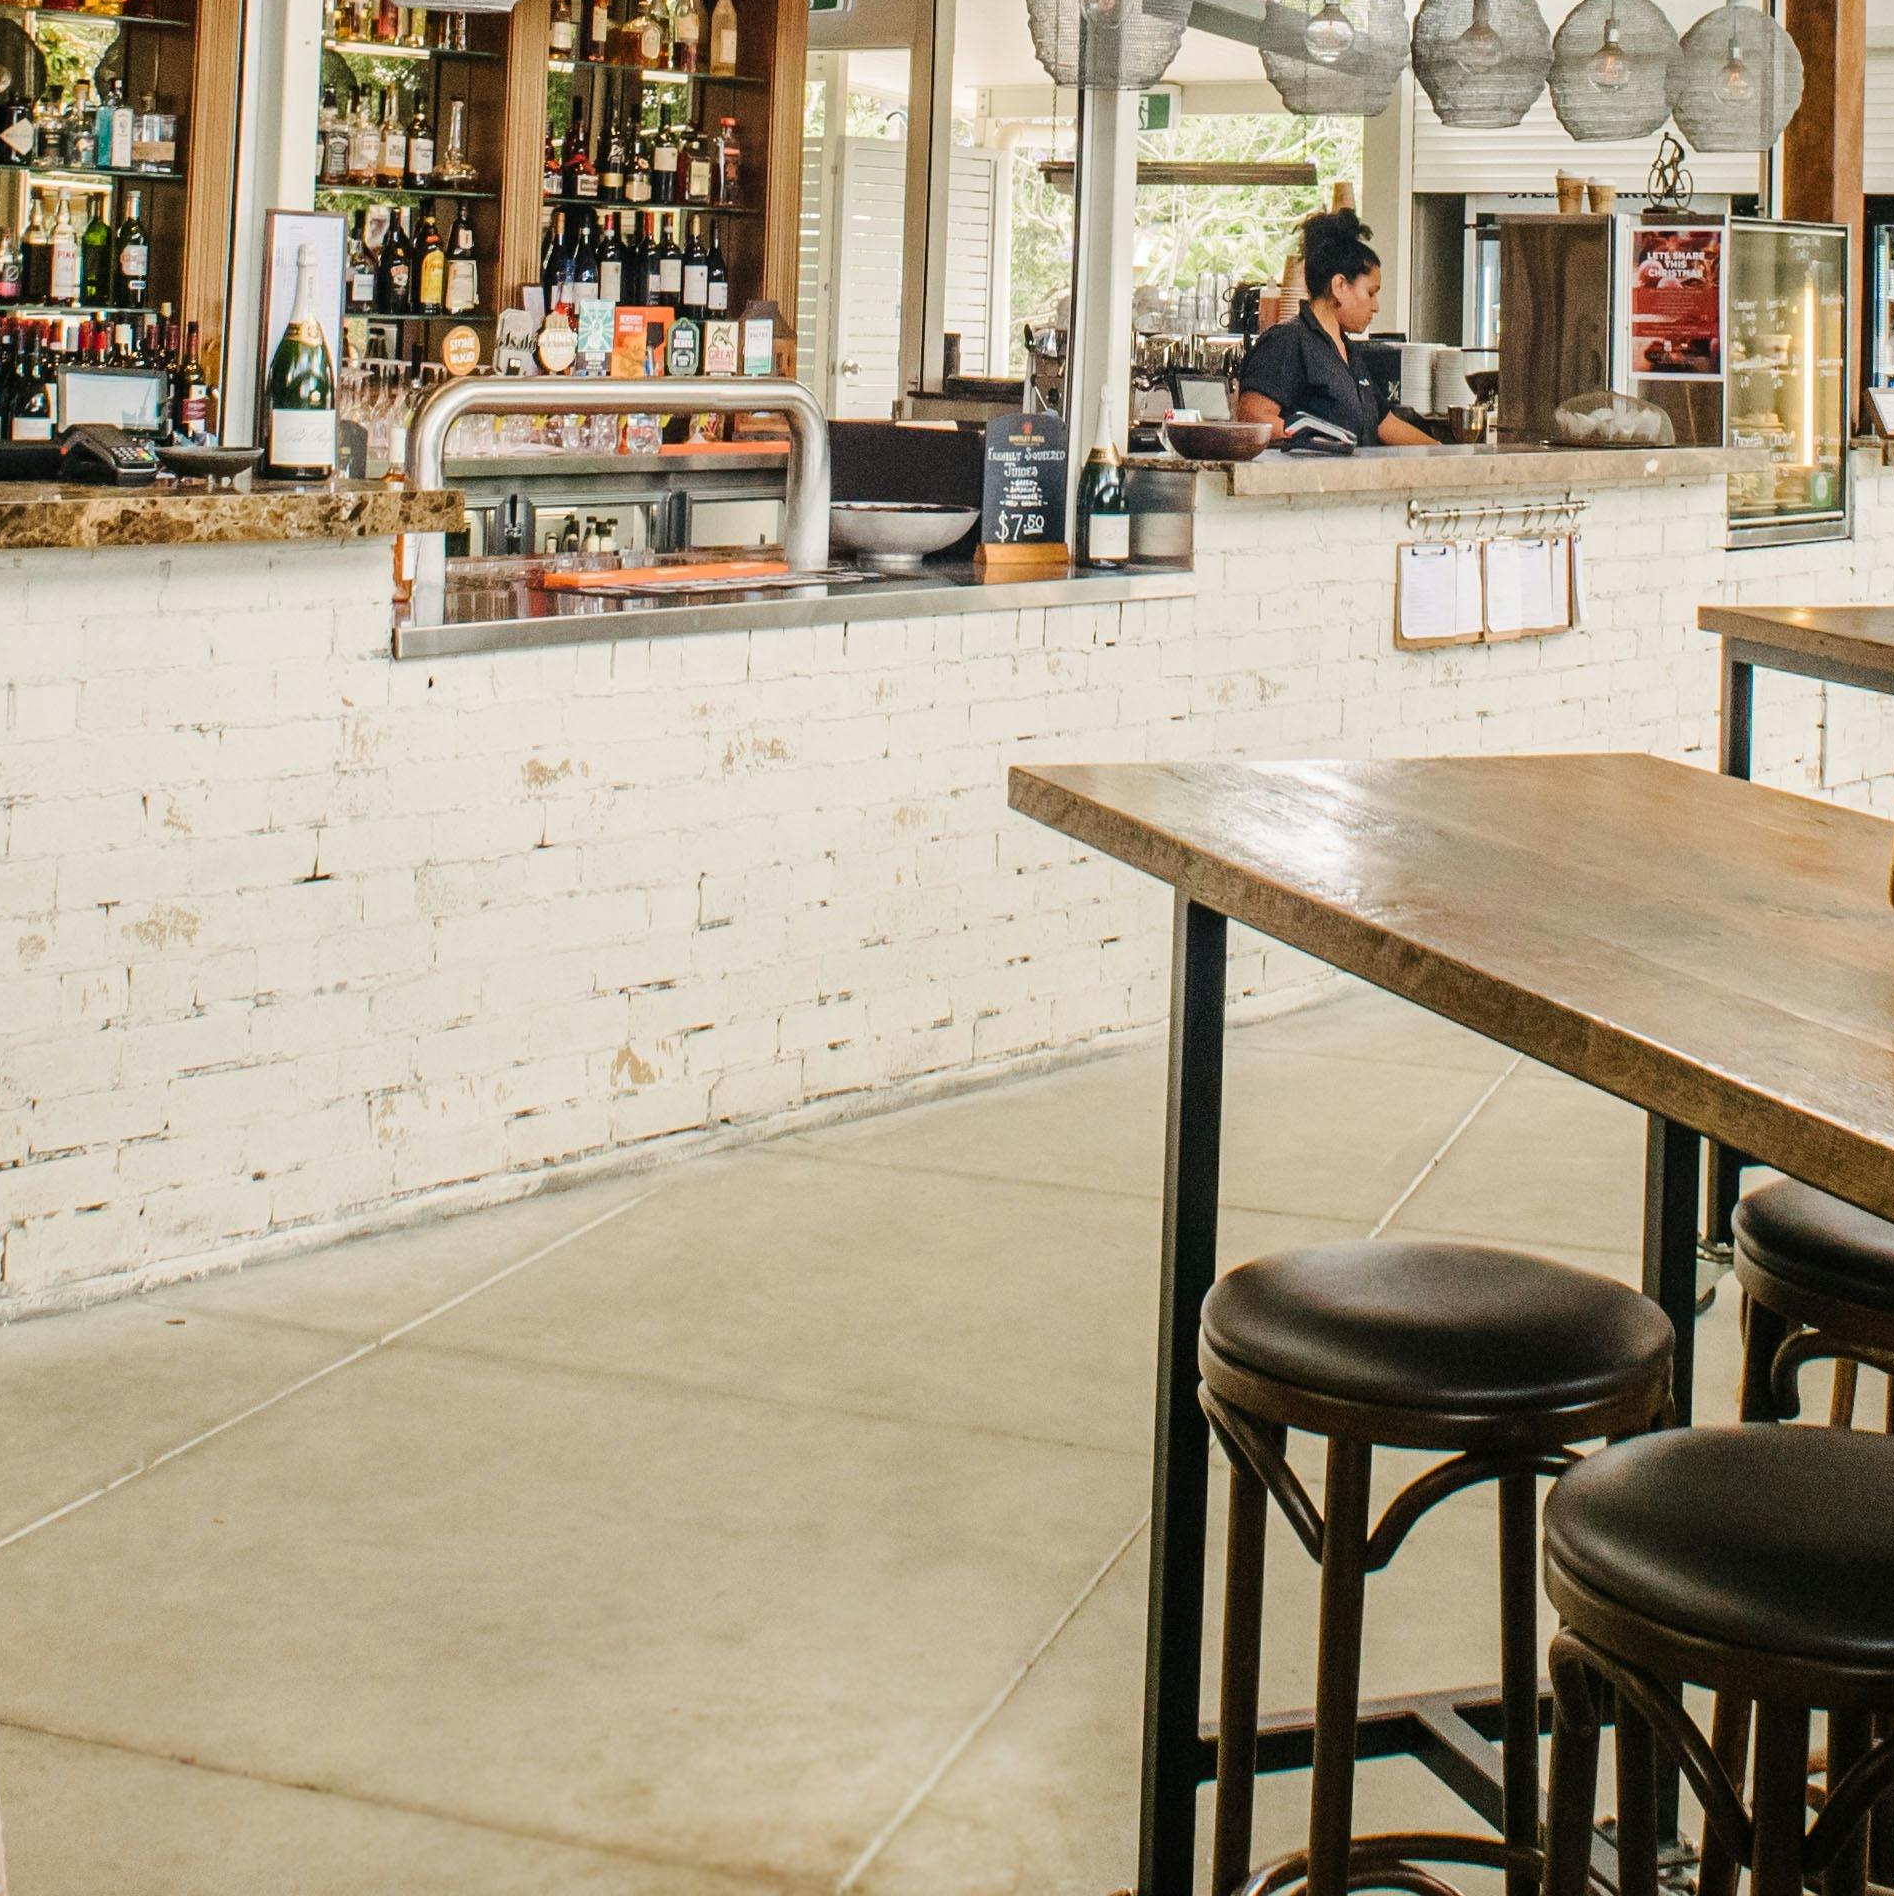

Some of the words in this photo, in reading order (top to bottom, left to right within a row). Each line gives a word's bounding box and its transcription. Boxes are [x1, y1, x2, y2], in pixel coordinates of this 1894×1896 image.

[1672, 251, 1706, 262] SHARE
[1665, 260, 1687, 269] THIS
[995, 510, 1045, 543] $7.50
